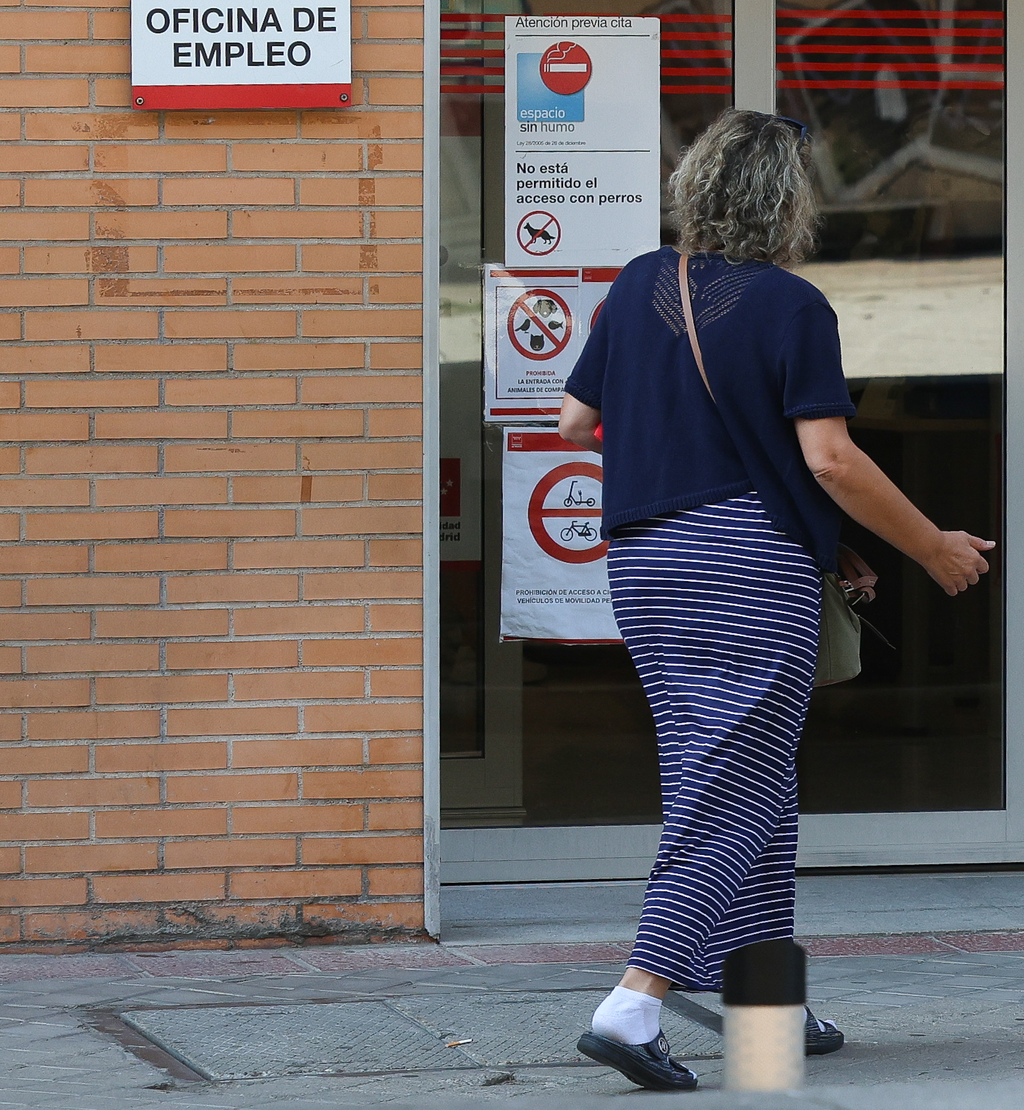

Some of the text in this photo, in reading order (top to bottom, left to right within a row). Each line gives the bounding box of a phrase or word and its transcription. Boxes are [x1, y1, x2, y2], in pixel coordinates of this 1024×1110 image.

[146, 7, 337, 34] OFICINA DE
[515, 16, 633, 30] Atención previa cita
[173, 40, 311, 67] EMPLEO
[520, 106, 566, 121] espacio
[519, 121, 575, 133] sin humo
[516, 161, 569, 174] No está
[516, 177, 598, 191] permitido el
[516, 193, 643, 205] acceso con perros
[440, 532, 461, 541] drid
[516, 588, 557, 596] PROHIBICIÓN
